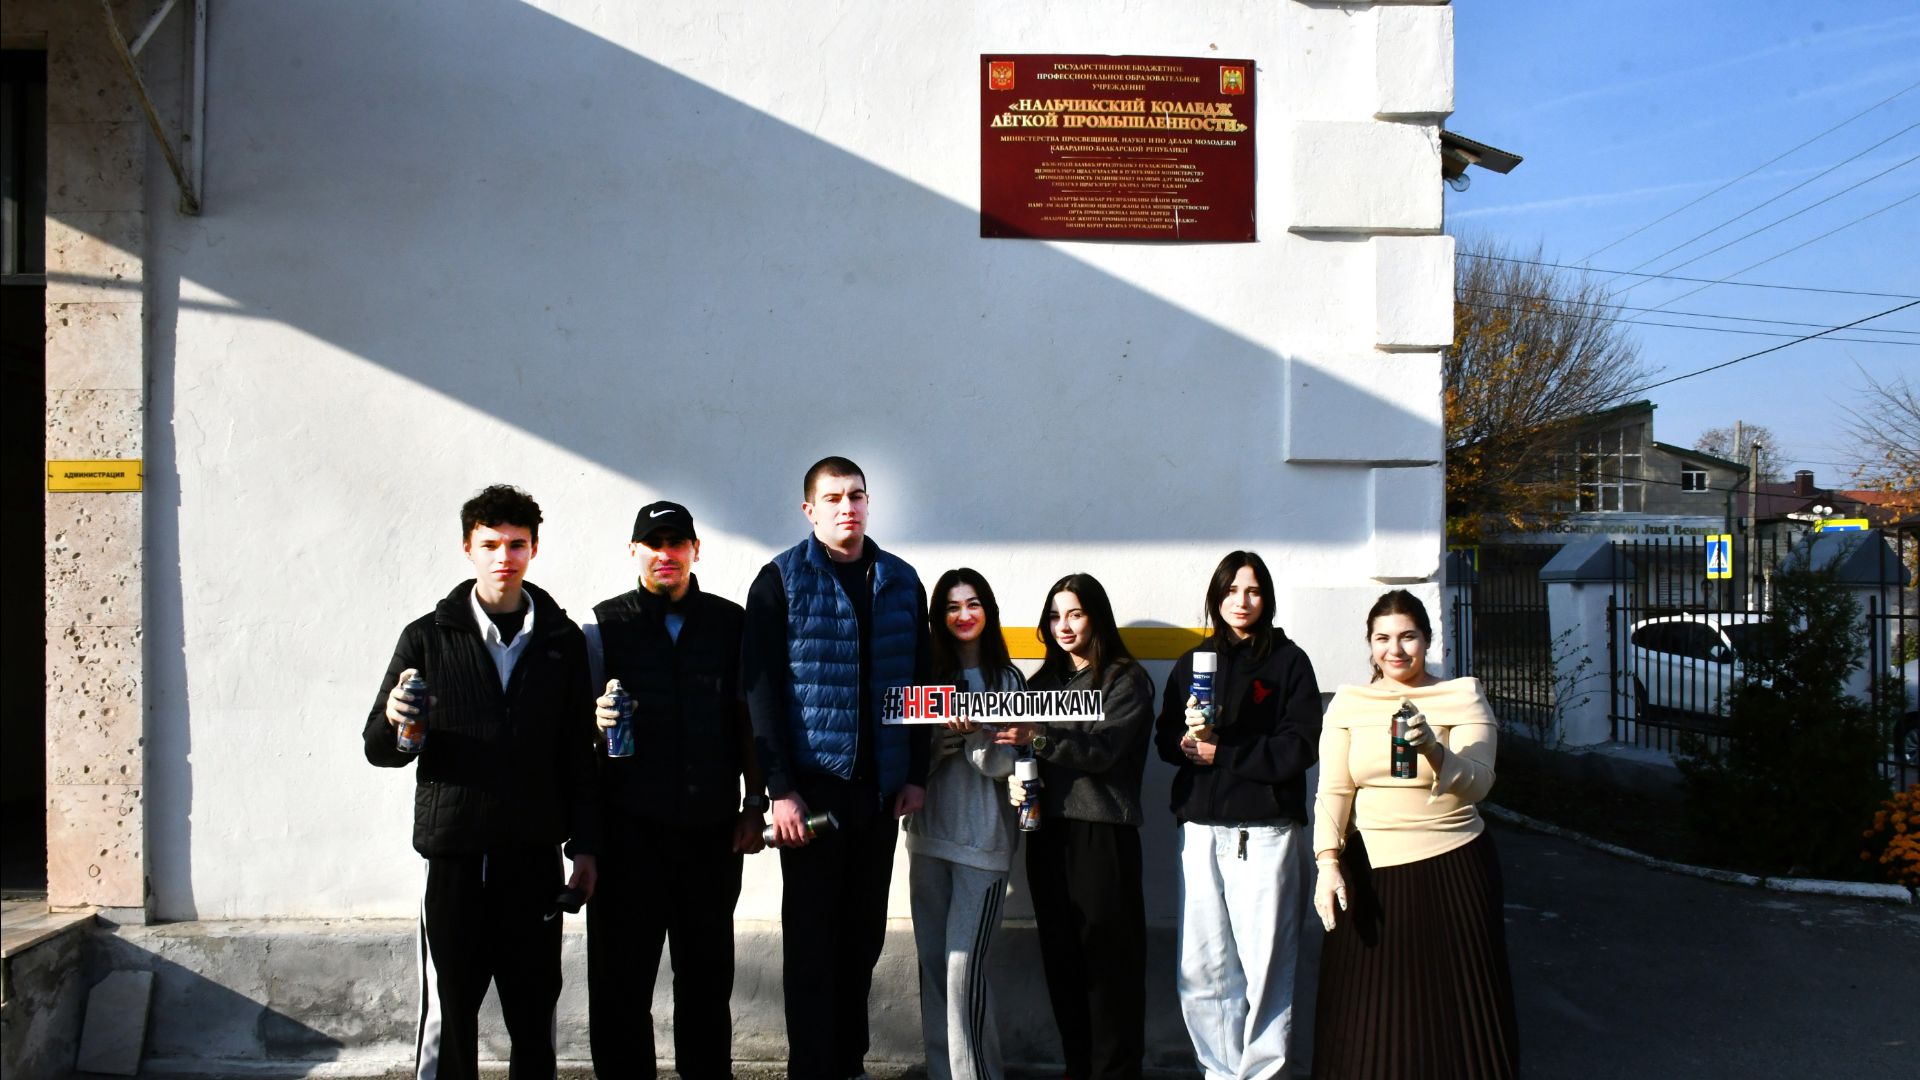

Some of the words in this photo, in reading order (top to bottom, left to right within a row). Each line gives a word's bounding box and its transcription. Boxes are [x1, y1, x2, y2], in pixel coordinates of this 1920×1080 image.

[1053, 63, 1130, 71] ГОСУДАРСТВЕННОЕ
[1037, 73, 1124, 81] ПРОФЕССИОНАЛЬНОЕ
[1125, 74, 1200, 83] ОБРАЗОВАТЕЛЬНОЕ
[1092, 83, 1146, 91] УЧРЕЖДЕНИЕ
[1008, 98, 1145, 113] «НАЛЬЧИКСКИЙ
[1150, 101, 1233, 118] КОЛЛЕДЖ
[990, 112, 1059, 128] ЛЁГКОЙ
[1063, 114, 1248, 132] ПРОМЫШЛЕННОСТИ»
[1195, 139, 1237, 147] МОЛОДЕЖИ
[1641, 524, 1669, 535] Just
